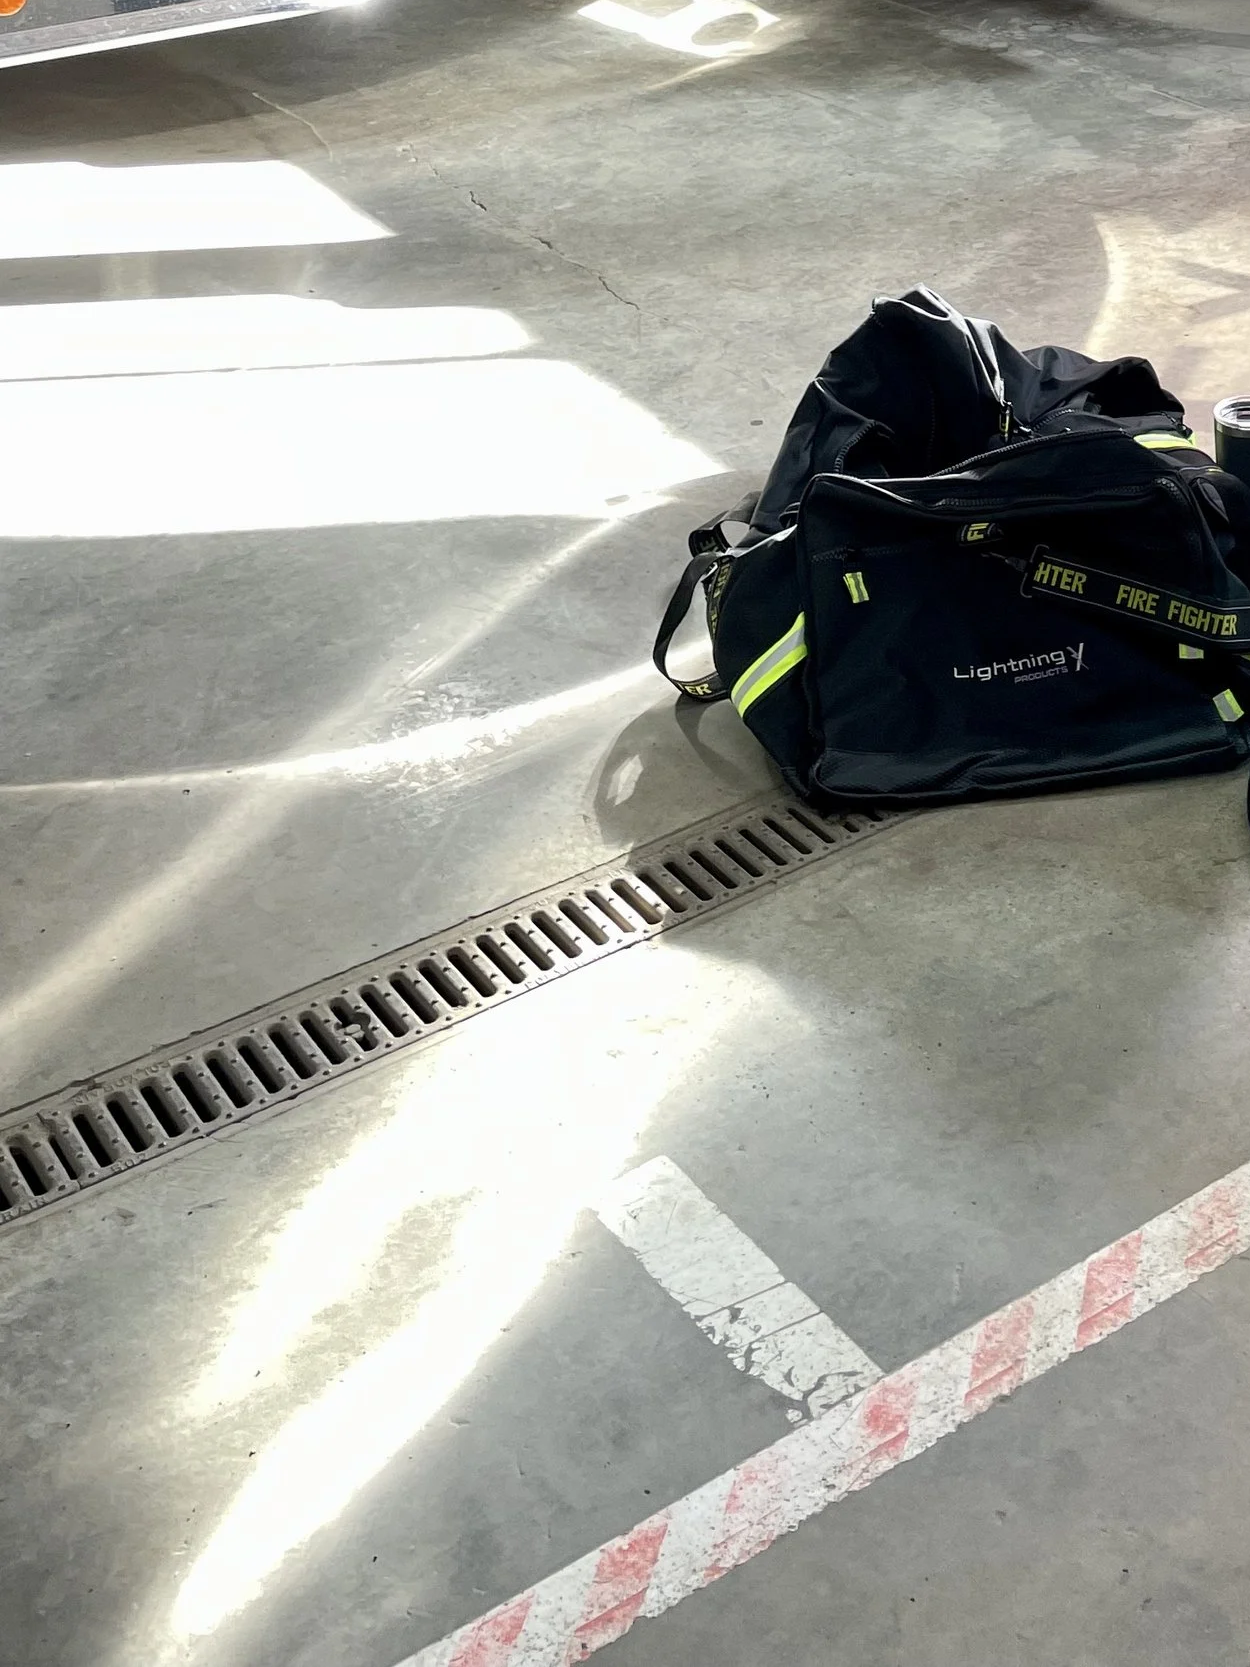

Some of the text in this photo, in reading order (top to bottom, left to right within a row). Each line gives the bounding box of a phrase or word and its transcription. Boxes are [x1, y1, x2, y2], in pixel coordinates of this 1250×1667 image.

[1116, 584, 1160, 615] FIRE
[1168, 599, 1238, 636] FIGHTER
[953, 650, 1066, 682] Lightning
[1014, 665, 1070, 685] PRODUCTS
